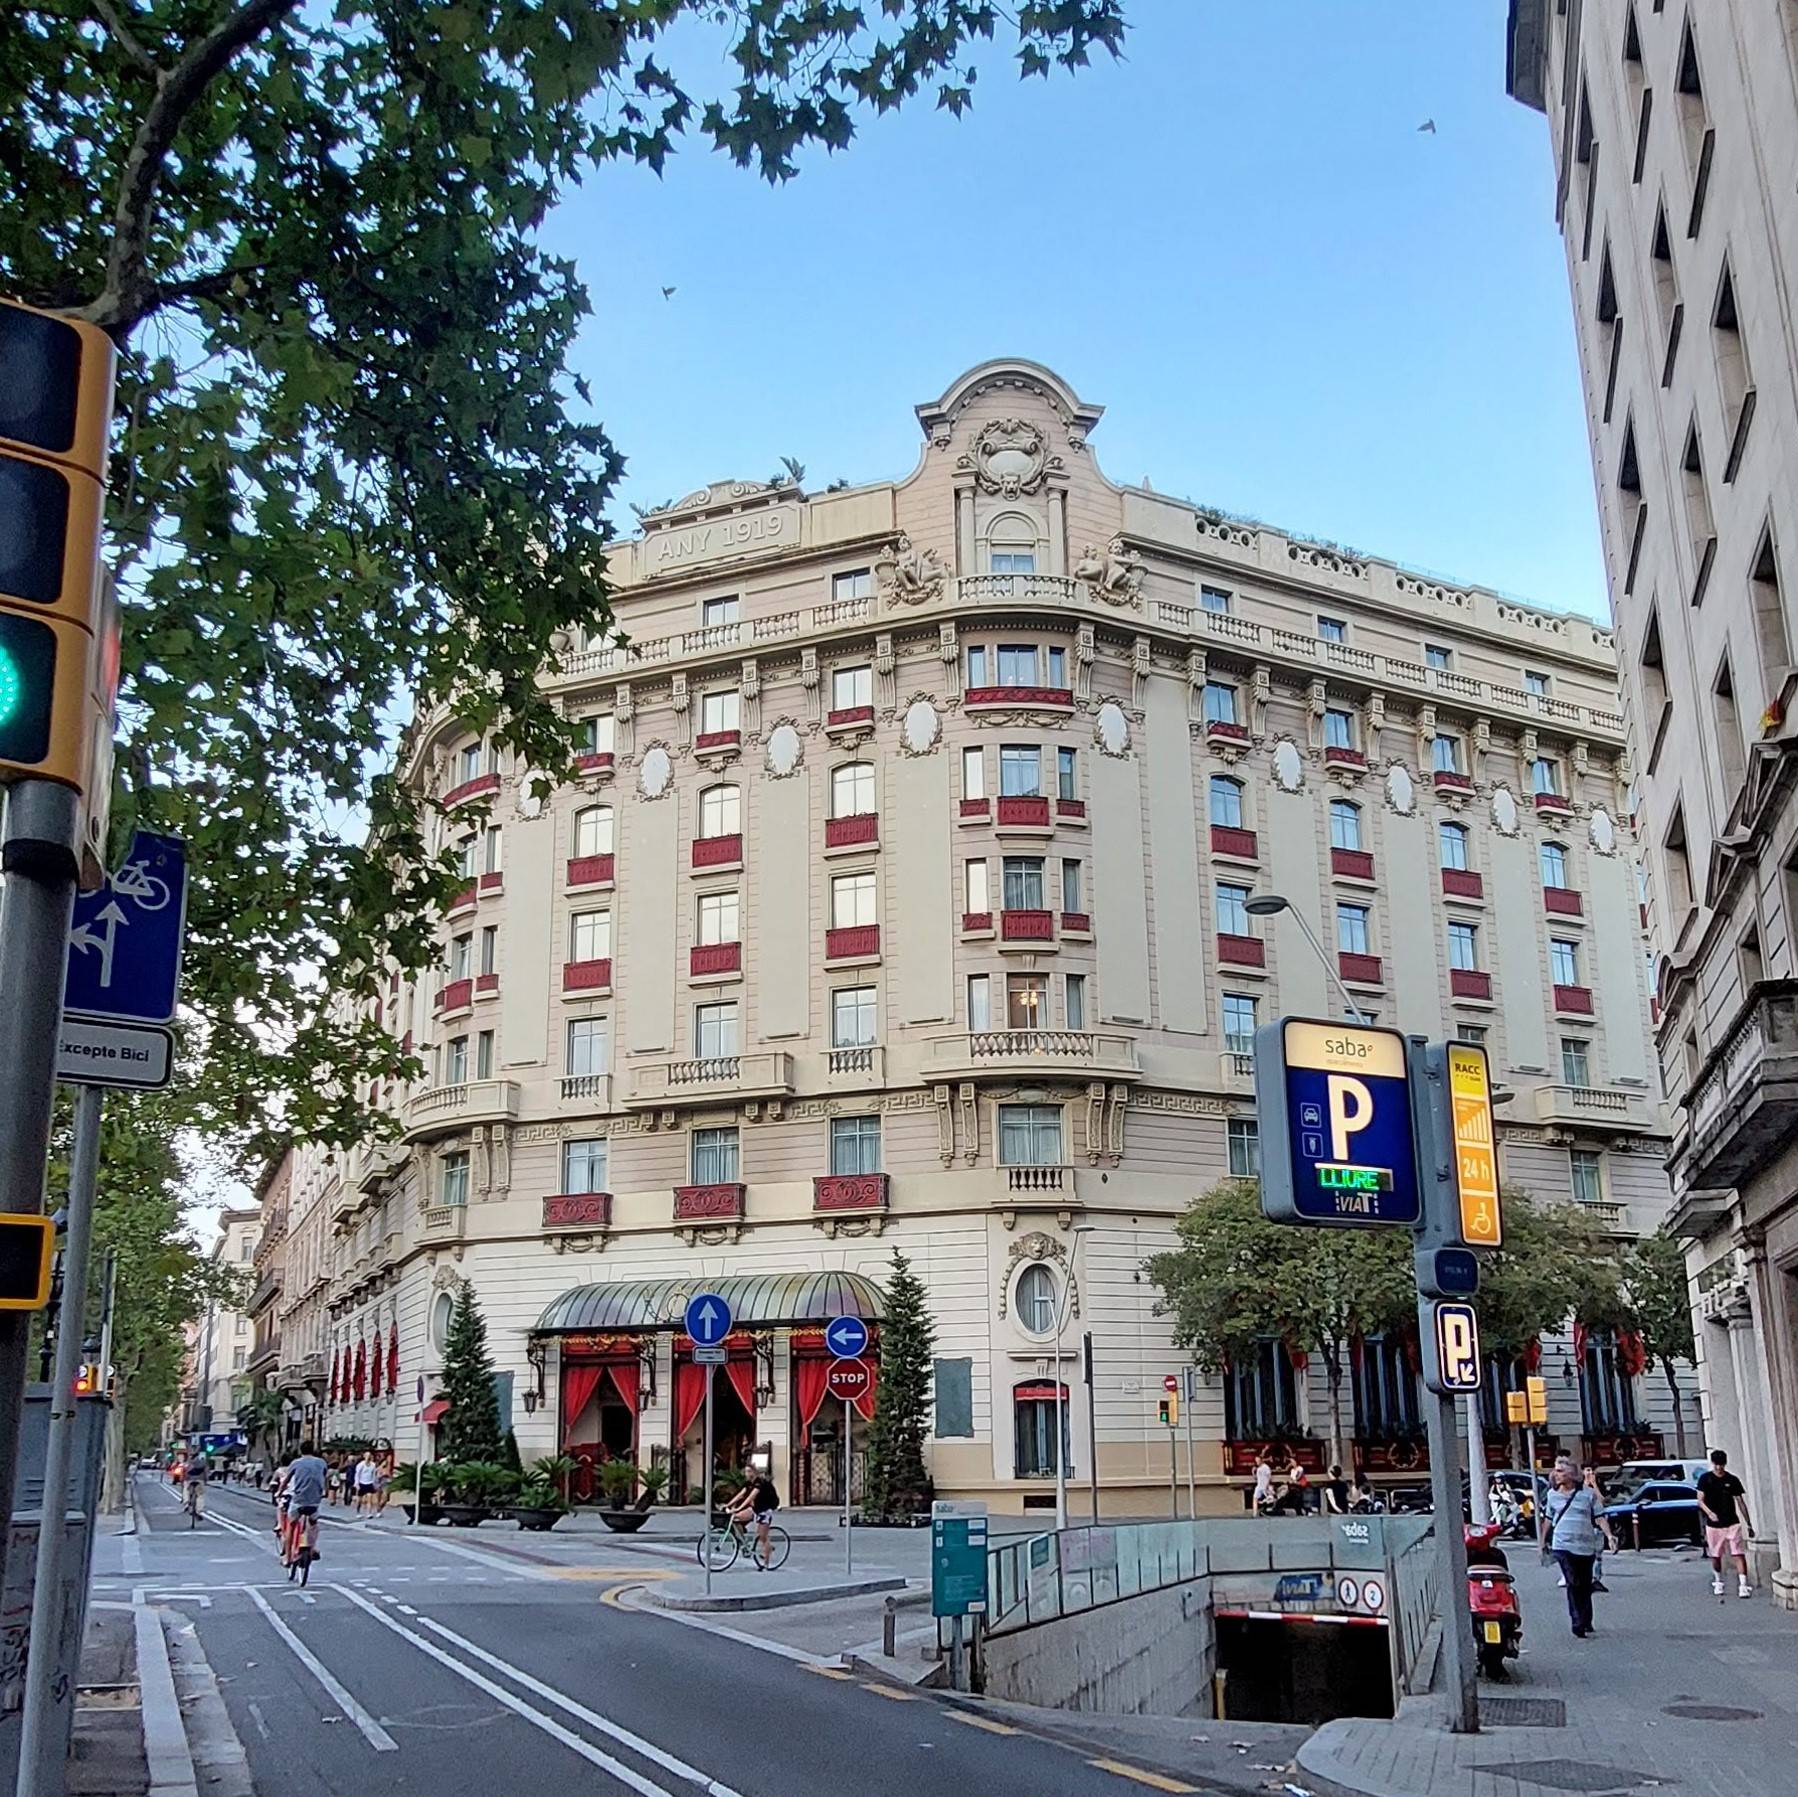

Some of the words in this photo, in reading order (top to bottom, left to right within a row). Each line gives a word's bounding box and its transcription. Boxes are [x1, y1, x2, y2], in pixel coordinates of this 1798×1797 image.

[658, 529, 711, 561] ANY
[723, 515, 783, 547] 1919
[120, 1047, 149, 1062] Bici
[1455, 1063, 1481, 1075] RACC
[1327, 1074, 1373, 1161] P
[1463, 1157, 1479, 1179] 24
[1481, 1161, 1490, 1180] h
[1444, 1313, 1472, 1378] P
[832, 1373, 865, 1384] STOP
